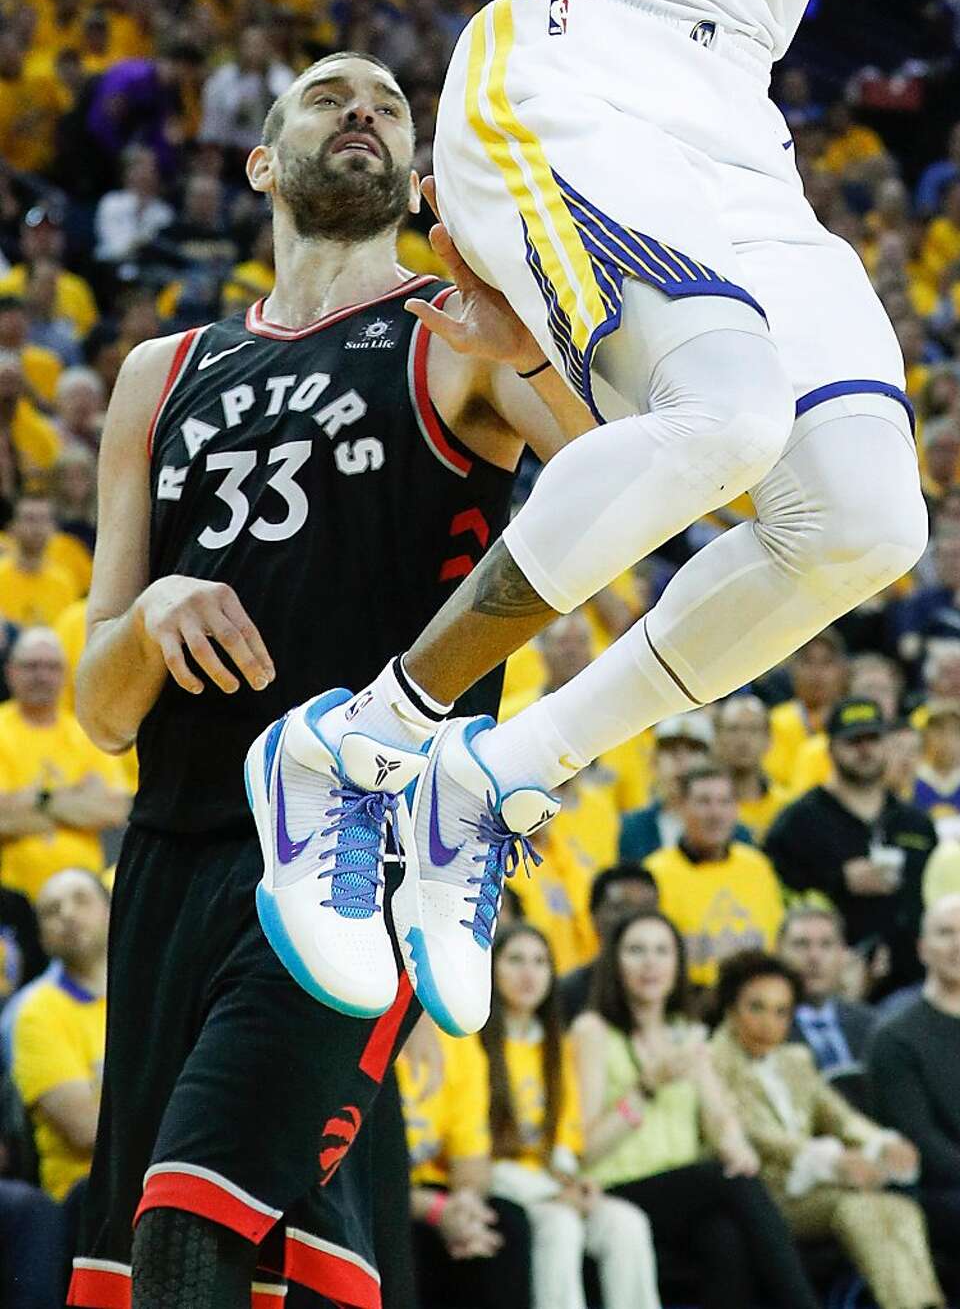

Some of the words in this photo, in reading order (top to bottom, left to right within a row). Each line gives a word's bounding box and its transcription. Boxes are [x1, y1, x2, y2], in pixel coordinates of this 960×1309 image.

[344, 340, 369, 350] Sun
[370, 339, 395, 349] Life
[157, 372, 385, 502] RAPTORS
[197, 440, 314, 550] 33
